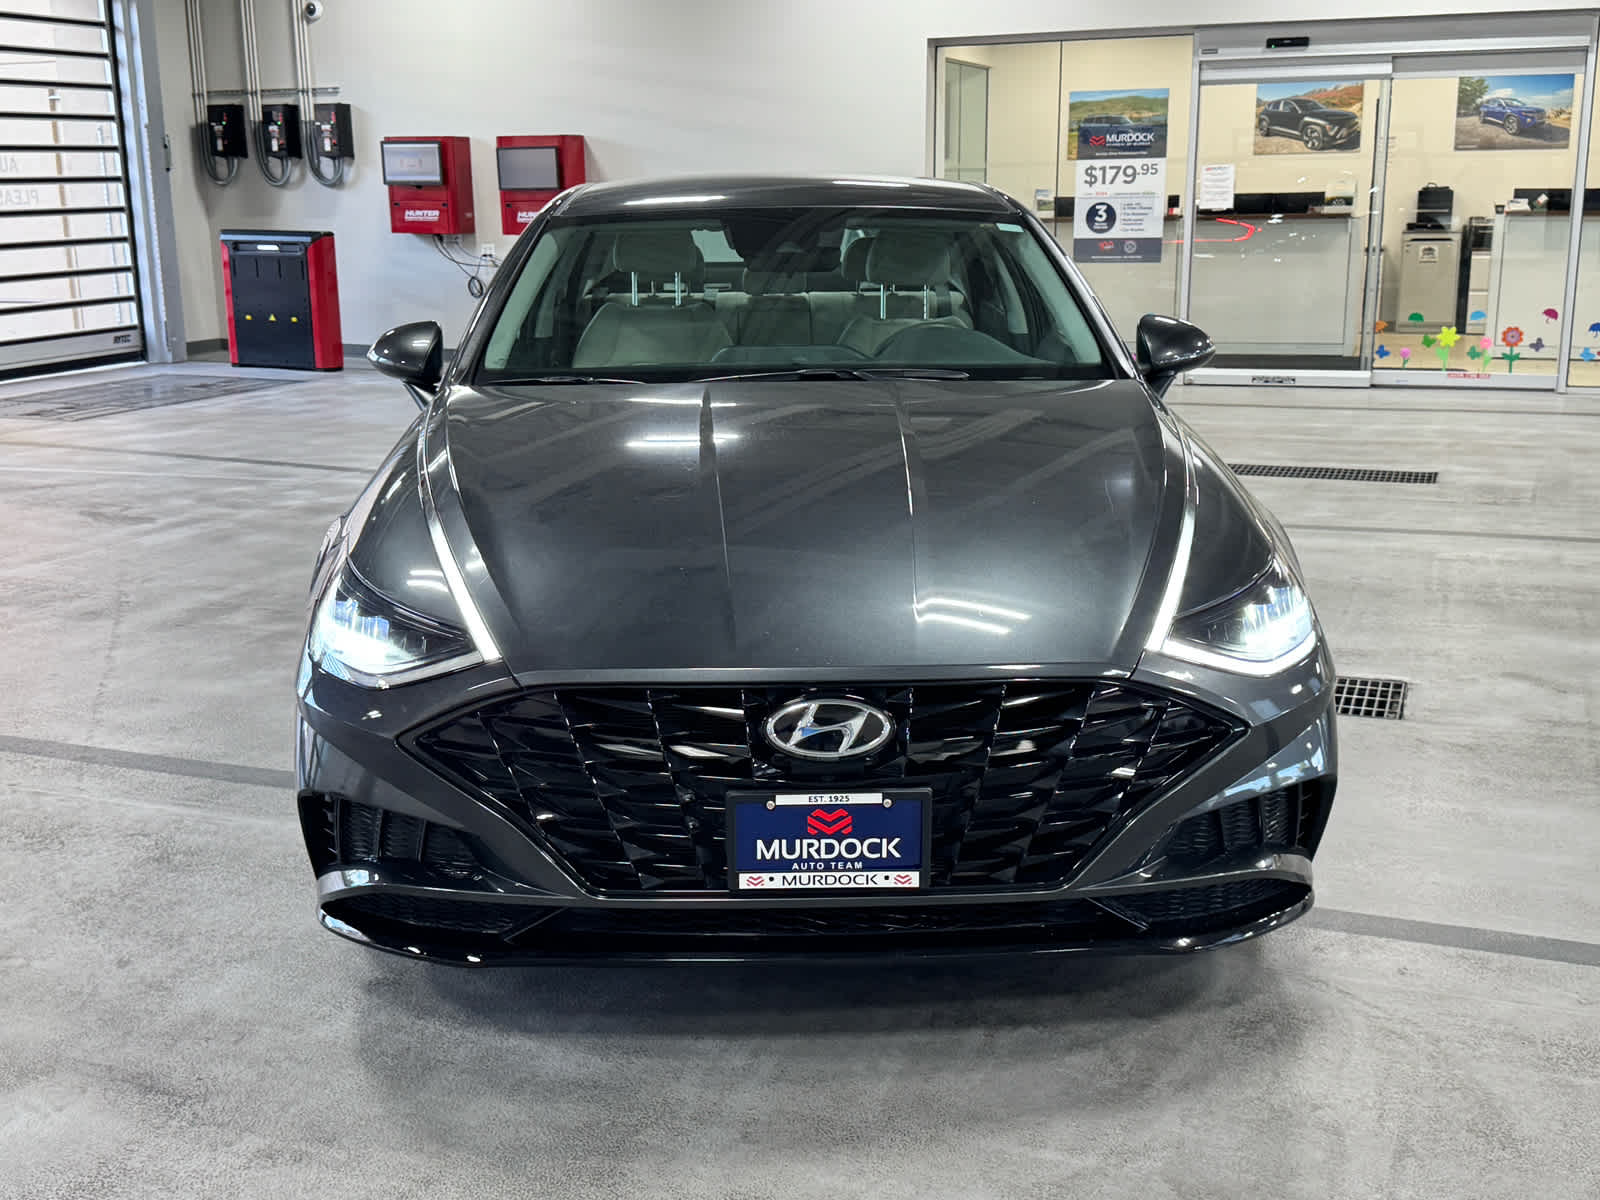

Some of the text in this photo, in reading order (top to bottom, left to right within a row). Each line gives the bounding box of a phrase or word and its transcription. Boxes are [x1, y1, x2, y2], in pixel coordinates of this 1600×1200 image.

[1106, 132, 1155, 143] MURDOCK
[1094, 204, 1108, 222] 3
[756, 838, 902, 861] MURDOCK
[791, 861, 863, 871] AUTO TEAM
[782, 874, 879, 886] MURDOCK
